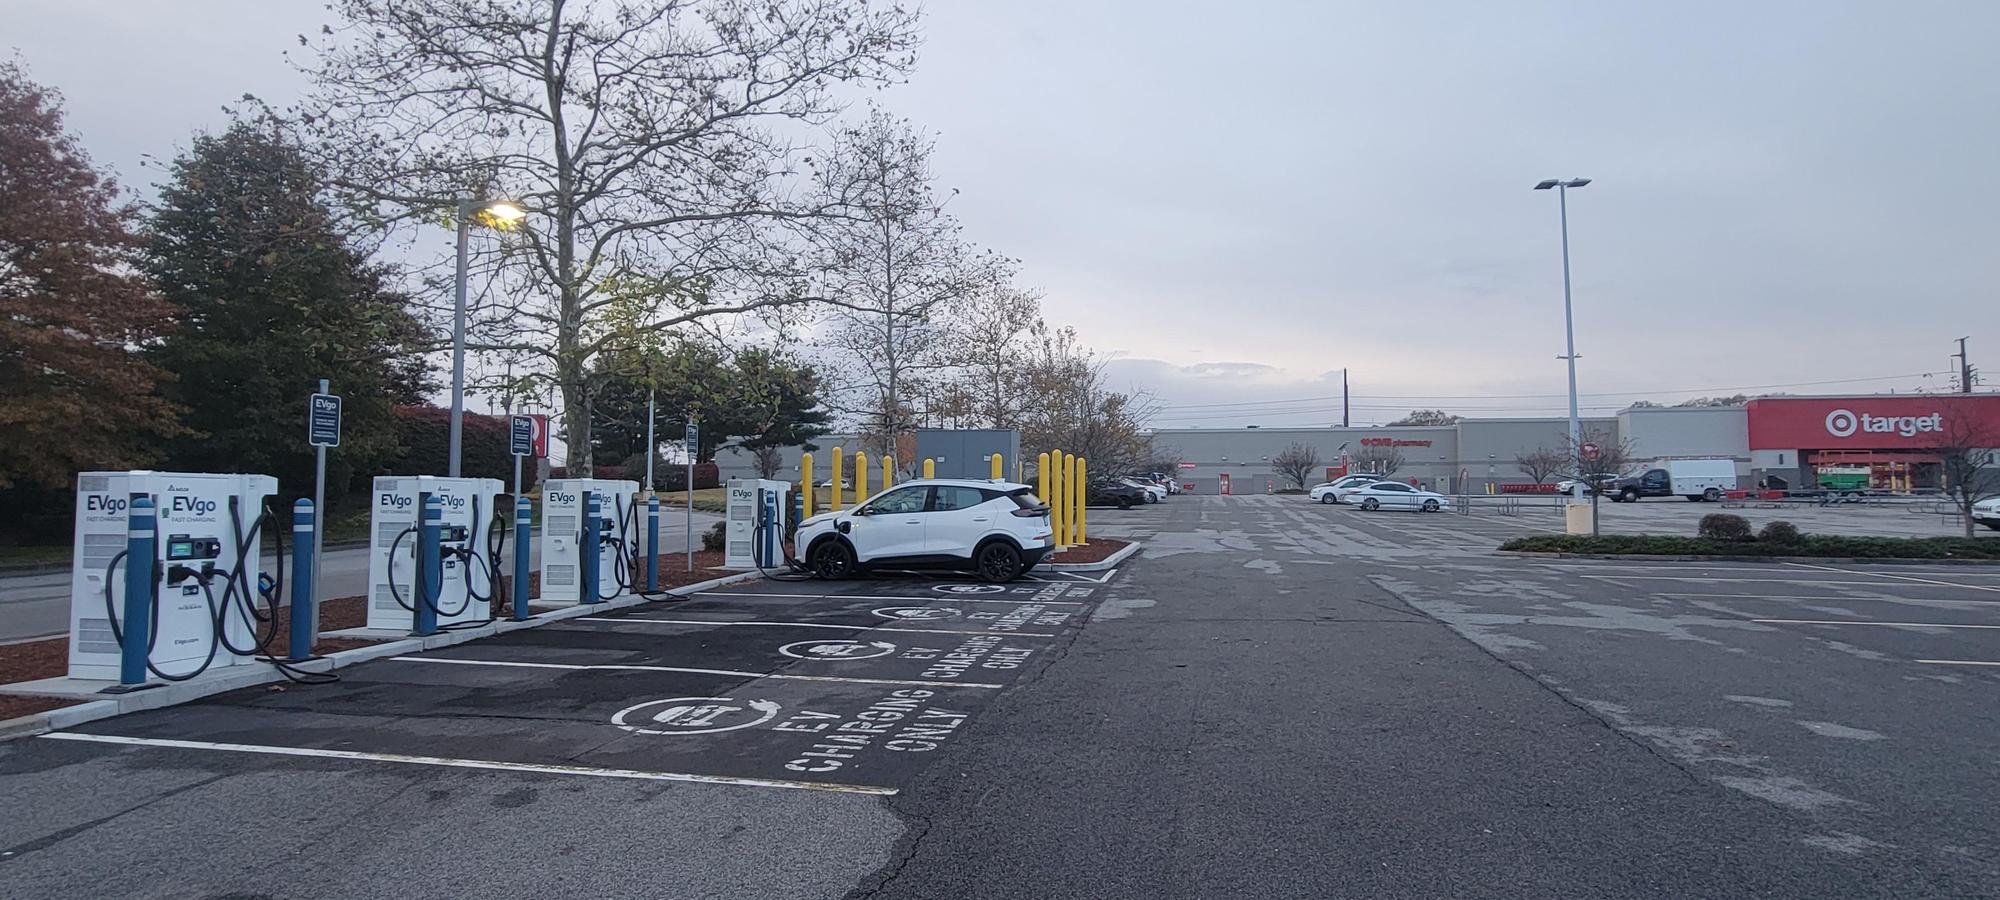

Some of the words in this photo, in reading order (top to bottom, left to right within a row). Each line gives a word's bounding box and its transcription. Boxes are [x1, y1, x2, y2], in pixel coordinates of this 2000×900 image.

[316, 399, 337, 411] EVgo
[514, 418, 530, 428] EVgo
[1861, 412, 1944, 437] target
[381, 493, 412, 509] EVgo
[440, 494, 465, 510] EVgo
[549, 492, 576, 505] EVgo
[732, 489, 753, 499] EVgo
[87, 494, 127, 515] EVgo
[172, 496, 217, 516] EVgo
[897, 647, 942, 660] EV
[921, 635, 1003, 678] CHARGING
[982, 647, 1034, 669] ONLY
[772, 710, 842, 733] EV
[784, 689, 935, 772] CHARGING
[884, 708, 969, 752] ONLY
